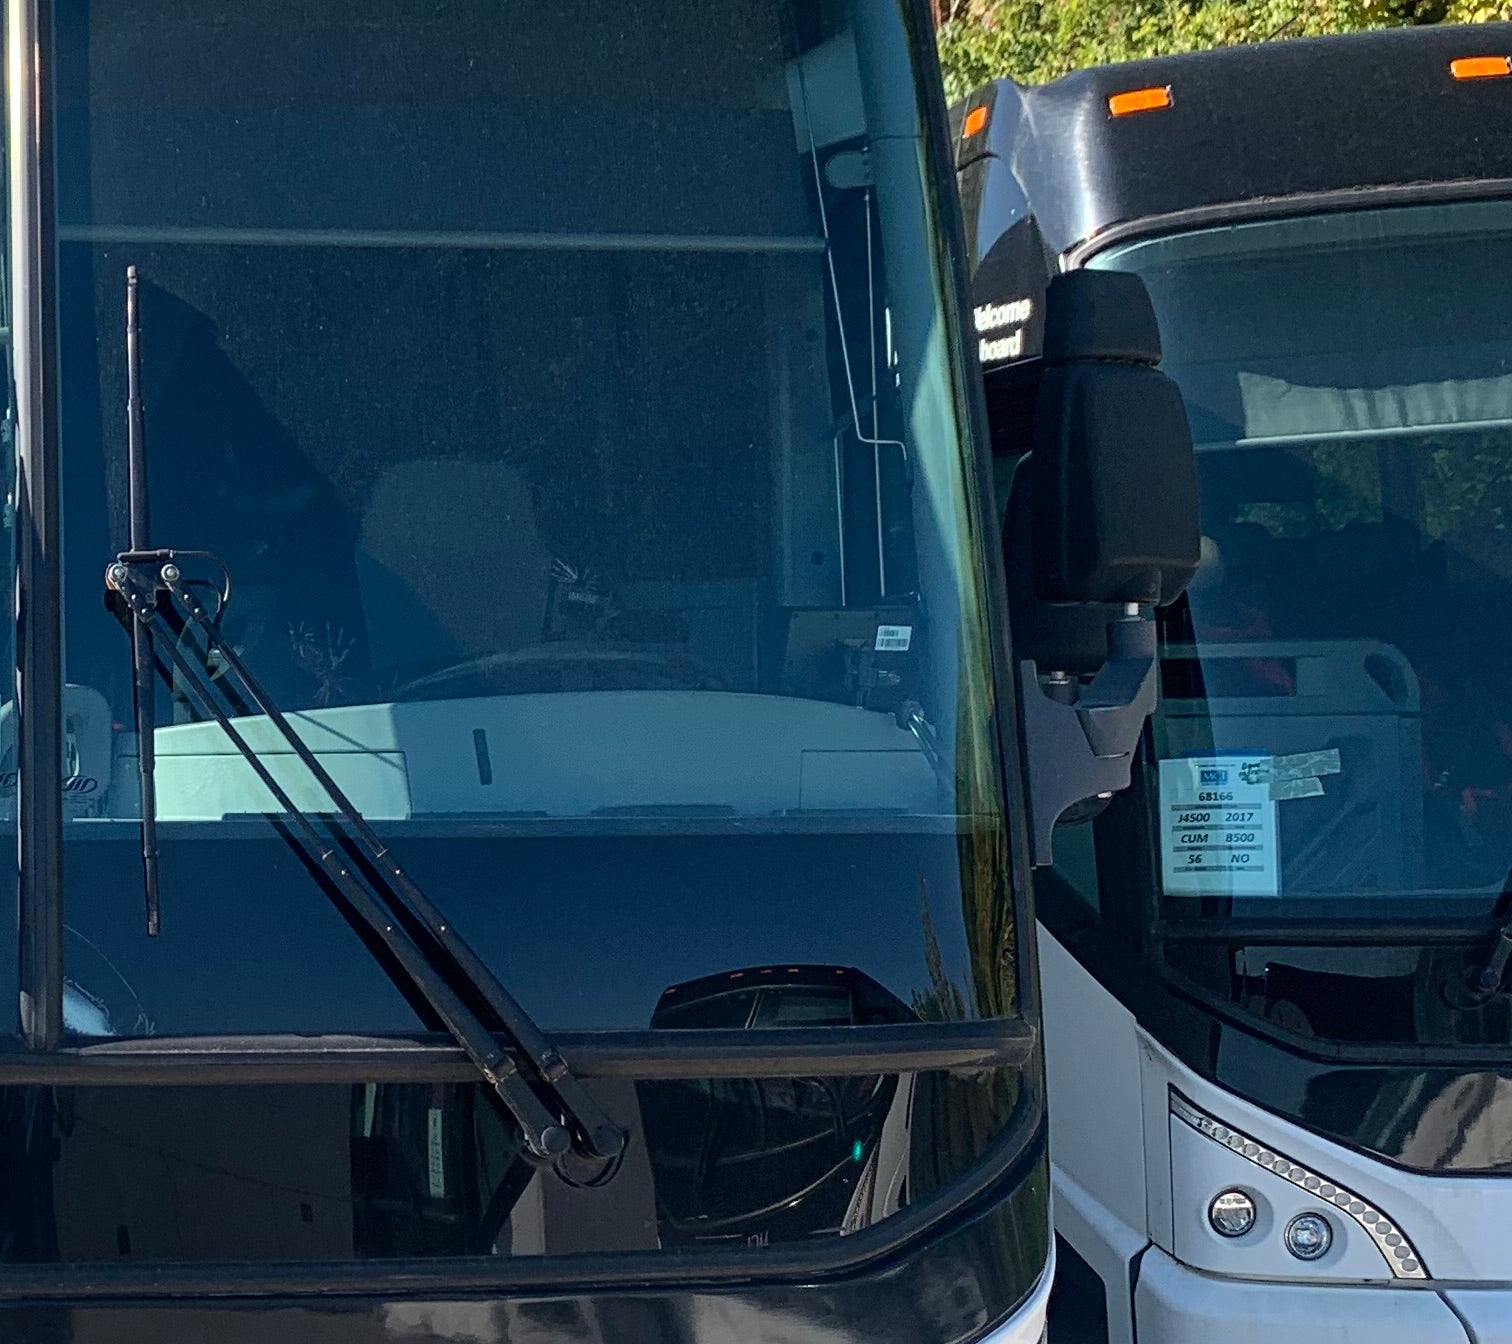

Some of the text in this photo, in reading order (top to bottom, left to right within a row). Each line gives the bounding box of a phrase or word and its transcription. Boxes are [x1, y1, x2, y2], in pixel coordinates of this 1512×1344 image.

[1198, 791, 1234, 802] 68166
[1178, 812, 1254, 823] J4500 2017
[1180, 833, 1209, 843] CUM
[1187, 854, 1250, 864] 56 NO
